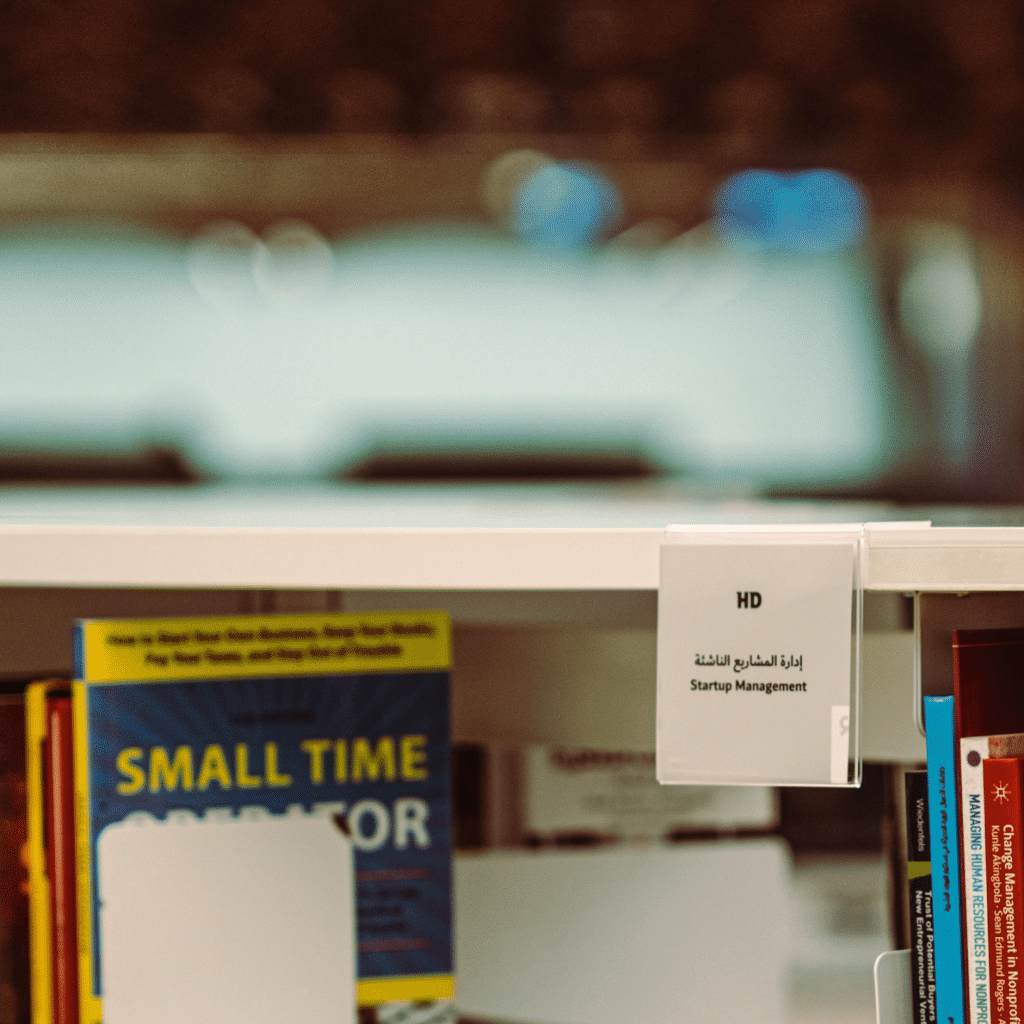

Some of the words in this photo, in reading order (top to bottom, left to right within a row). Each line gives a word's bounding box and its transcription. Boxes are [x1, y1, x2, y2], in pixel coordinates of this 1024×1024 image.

[736, 591, 762, 609] HD
[694, 654, 730, 667] الناشئة
[733, 655, 778, 673] المشاريع
[780, 655, 803, 672] إدارة
[690, 679, 732, 694] Startup
[735, 680, 808, 694] Management
[115, 742, 291, 795] SMALL
[301, 735, 429, 784] TIME
[969, 794, 983, 851] MANAGING
[1002, 824, 1015, 870] Change
[971, 853, 984, 892] HUMAN
[1003, 873, 1018, 953] Management
[972, 895, 986, 957] RESOURCES
[974, 960, 988, 981] FOR
[1008, 956, 1018, 968] in
